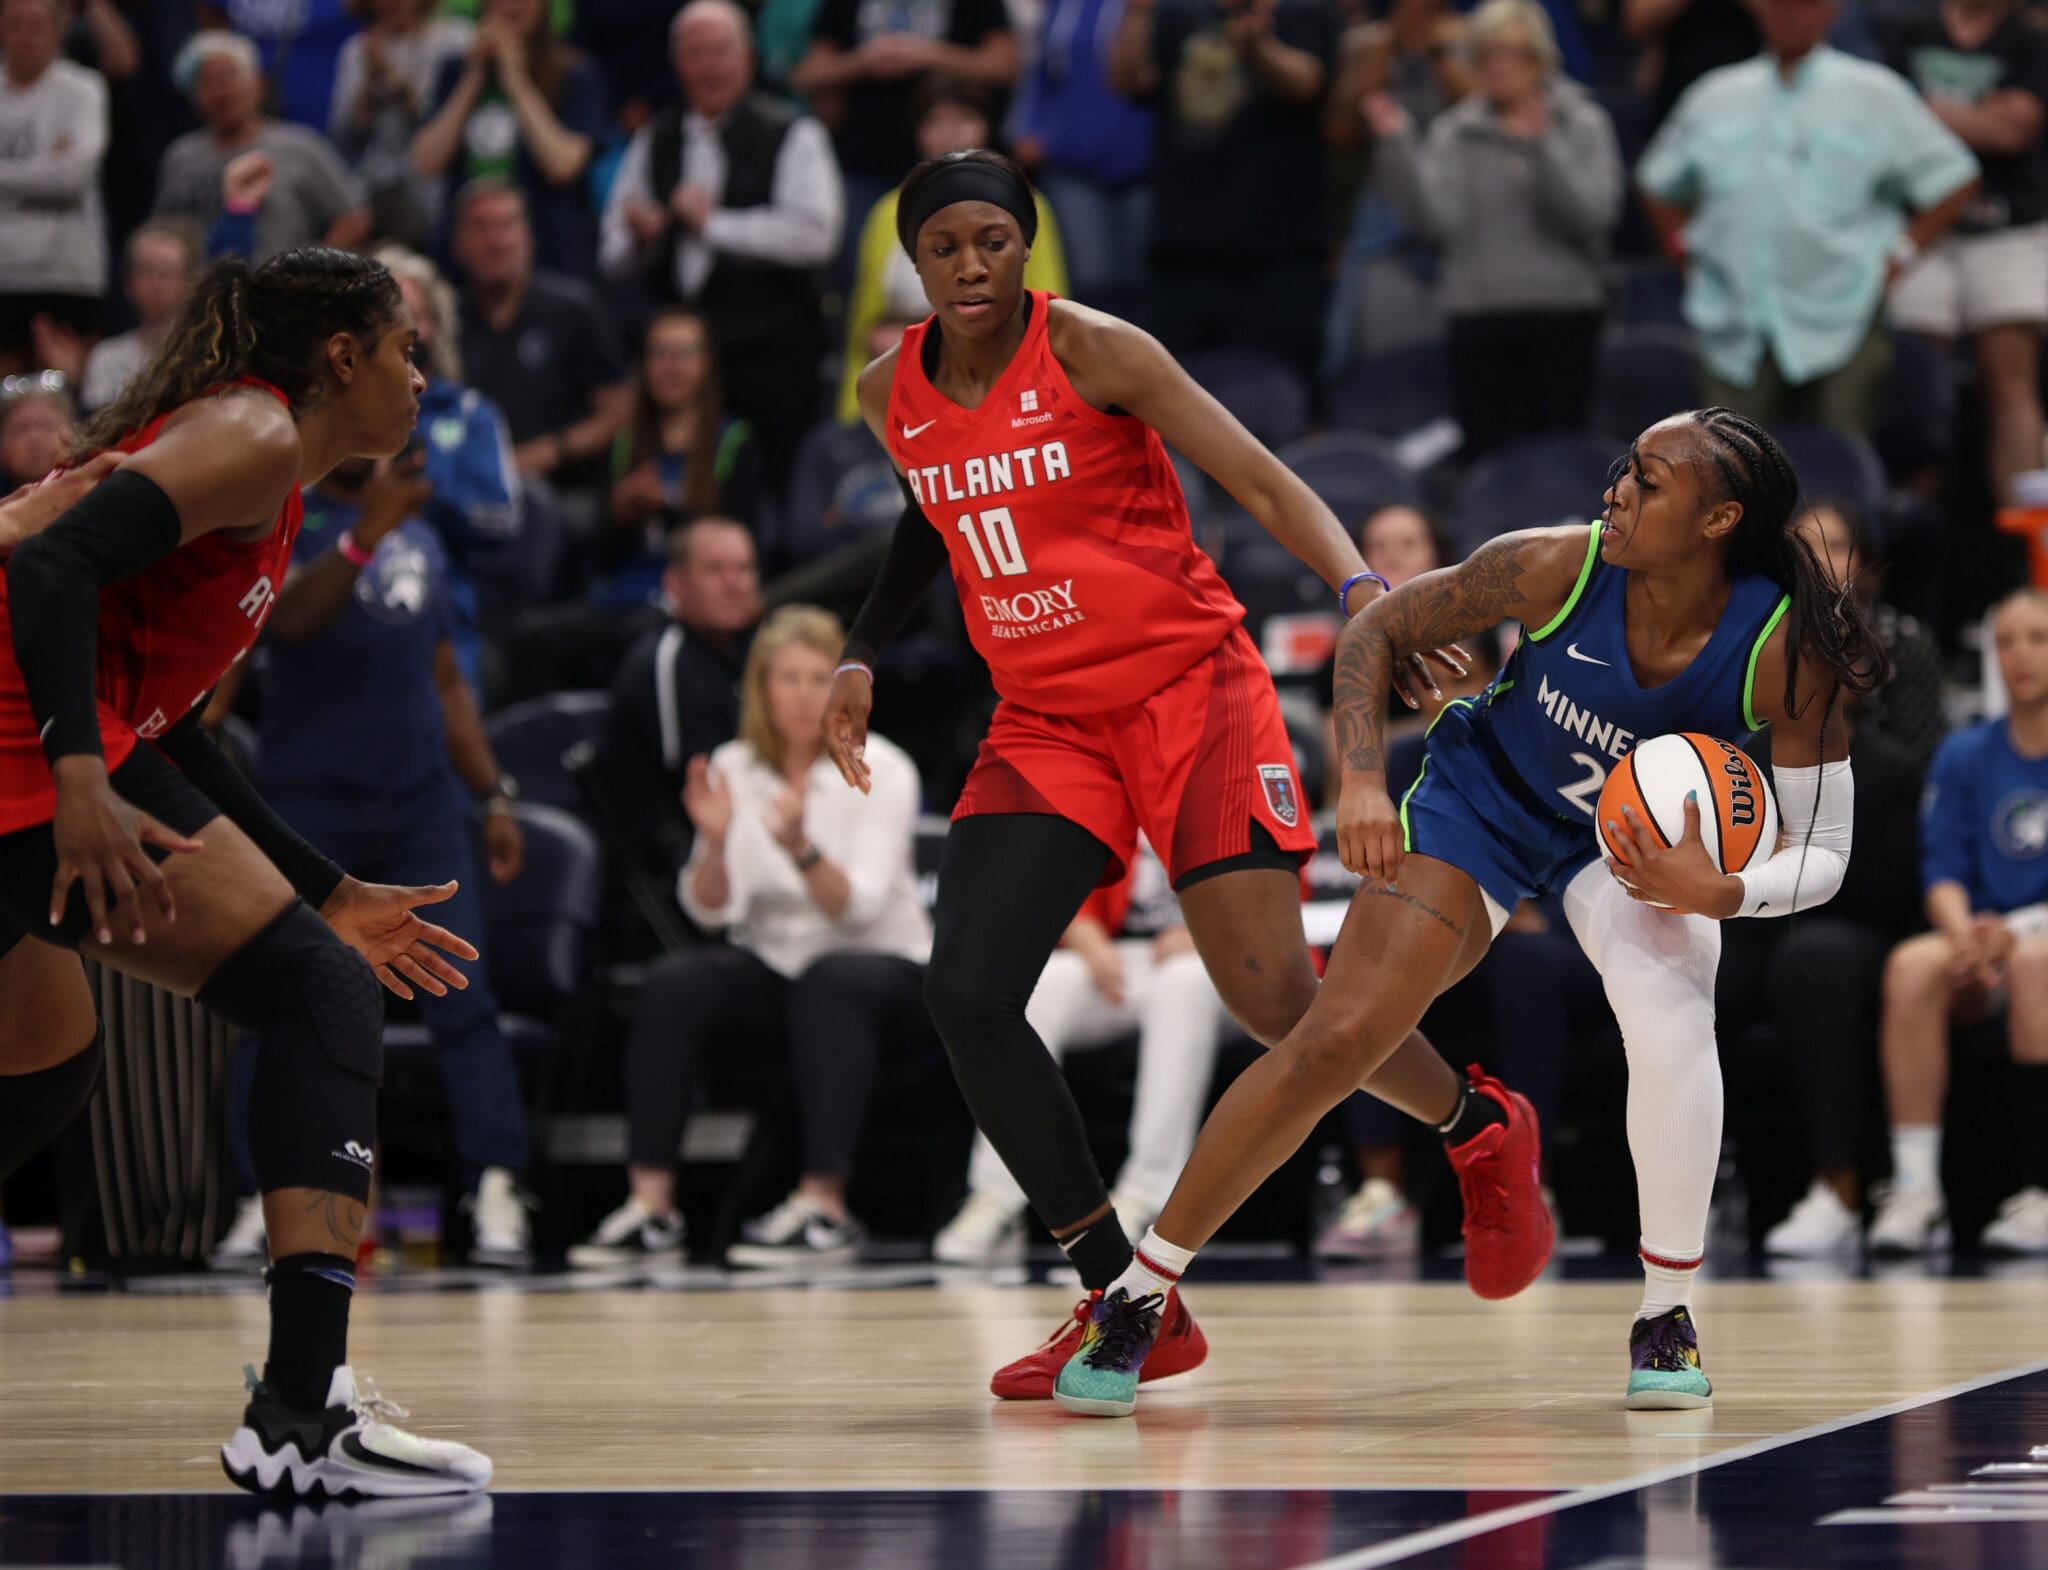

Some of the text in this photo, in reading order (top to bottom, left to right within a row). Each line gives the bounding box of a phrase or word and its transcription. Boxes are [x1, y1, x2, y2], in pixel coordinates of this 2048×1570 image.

[1011, 411, 1053, 429] Microsoft
[907, 440, 1071, 505] ATLANTA
[956, 505, 1029, 580] 10
[980, 578, 1078, 622] EMORY
[991, 610, 1085, 639] HEALTHCARE
[1537, 673, 1649, 761] MINNE
